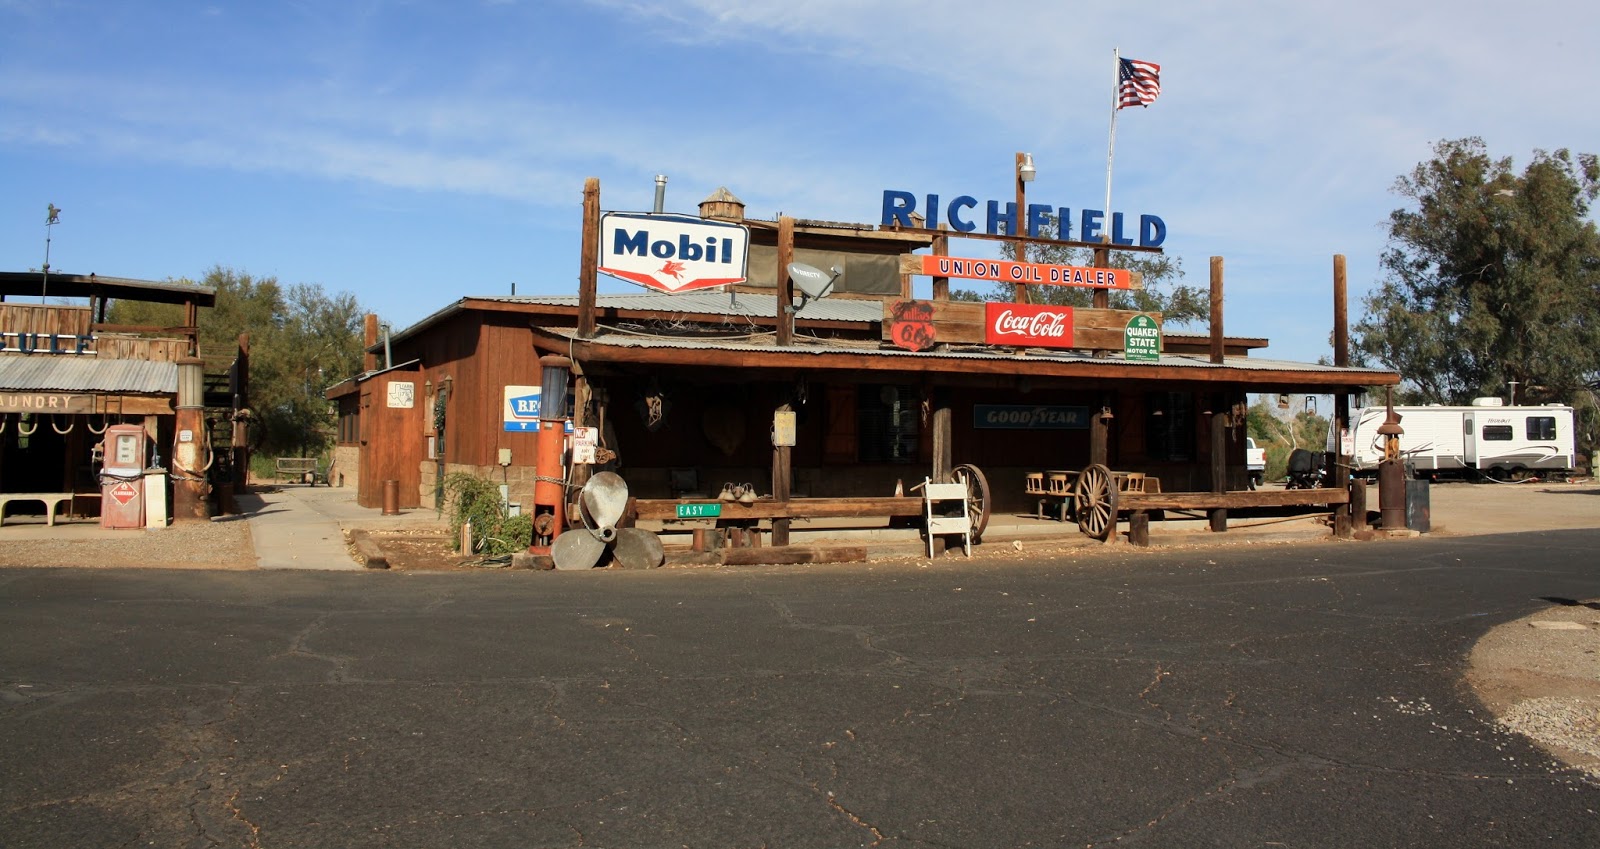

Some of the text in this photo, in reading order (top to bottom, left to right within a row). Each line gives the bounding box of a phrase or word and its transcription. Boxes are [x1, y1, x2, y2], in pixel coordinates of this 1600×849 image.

[881, 190, 1167, 247] RICHFIELD
[613, 228, 732, 264] Mobil
[939, 258, 1117, 286] UNION OIL DEALER
[995, 309, 1068, 339] Coca-Cola
[1127, 327, 1158, 338] QUAKER
[1130, 338, 1156, 348] STATE
[987, 408, 1078, 427] GOODYEAR
[575, 430, 585, 439] NO
[679, 505, 704, 516] EASY
